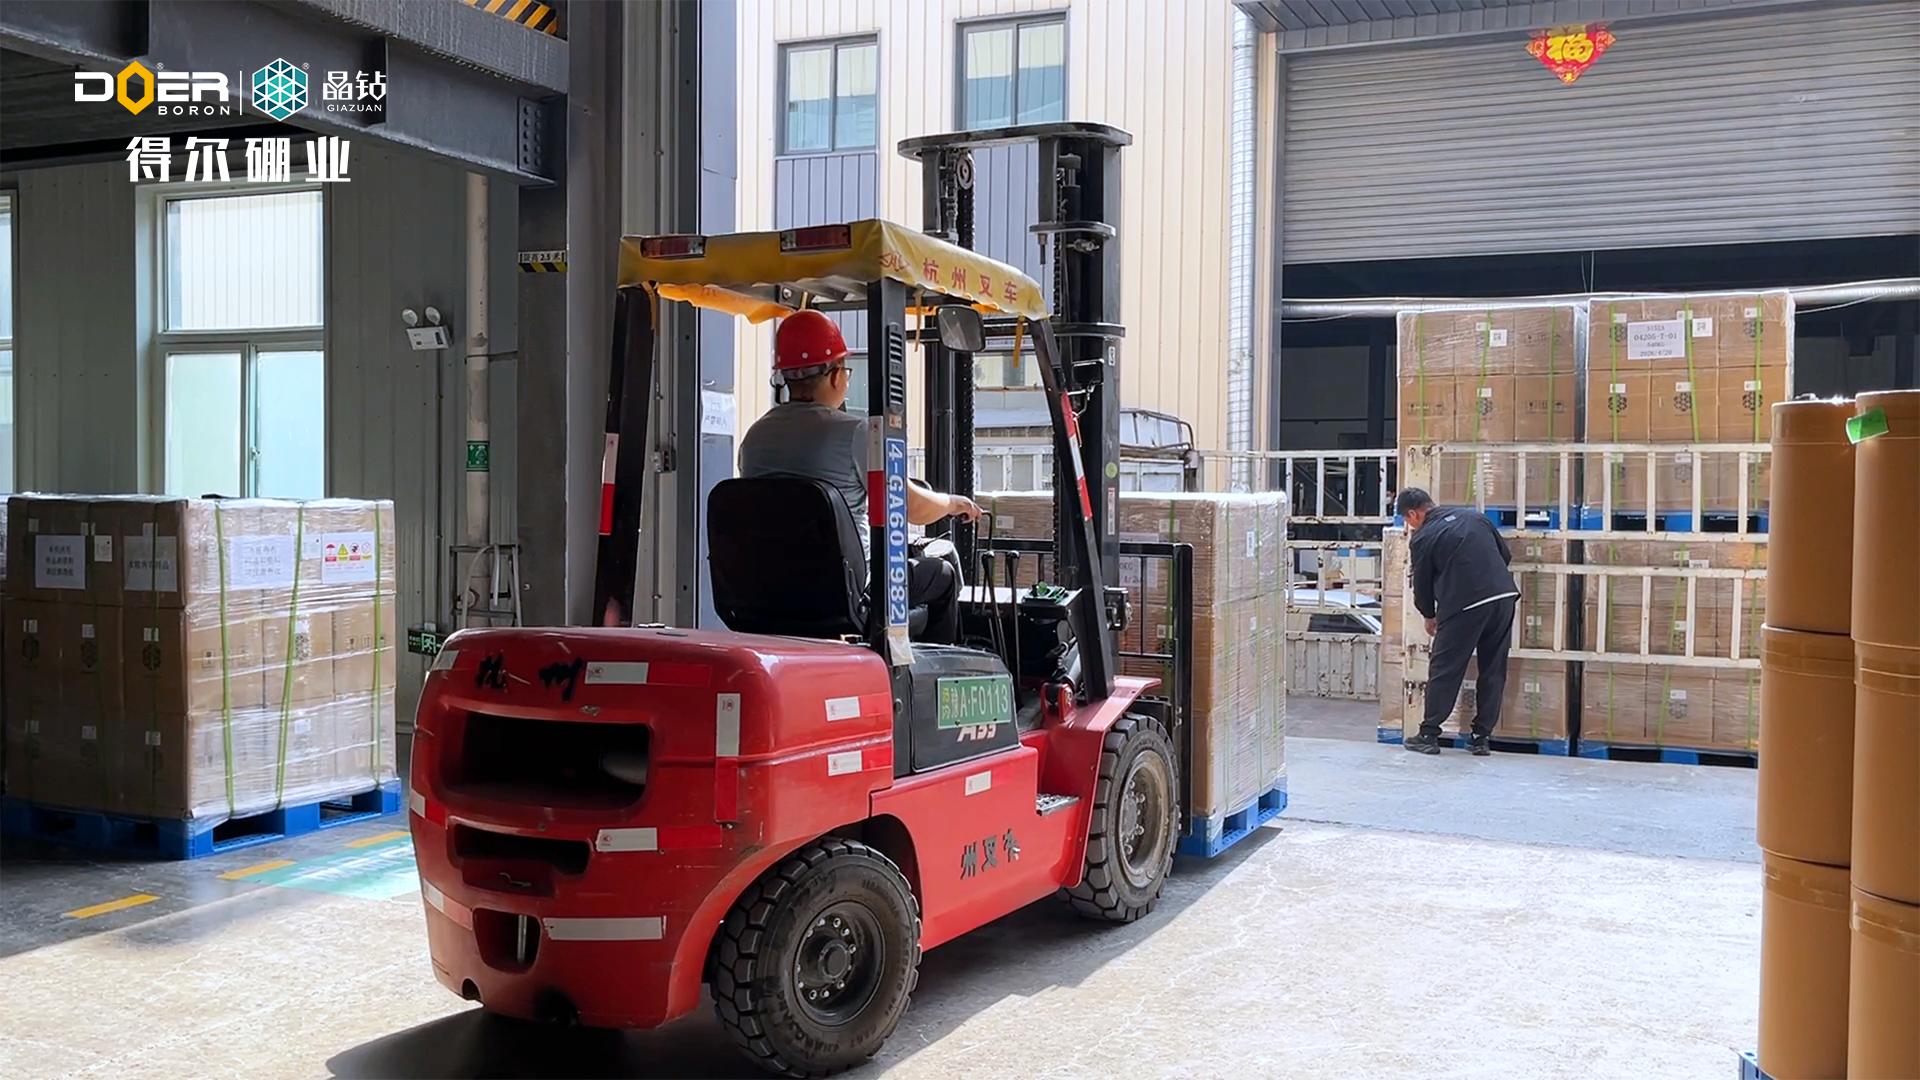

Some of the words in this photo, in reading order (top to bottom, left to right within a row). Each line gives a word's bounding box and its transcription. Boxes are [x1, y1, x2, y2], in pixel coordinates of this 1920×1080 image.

[922, 257, 1018, 305] 杭州叉车
[888, 443, 906, 621] 4-GA601982
